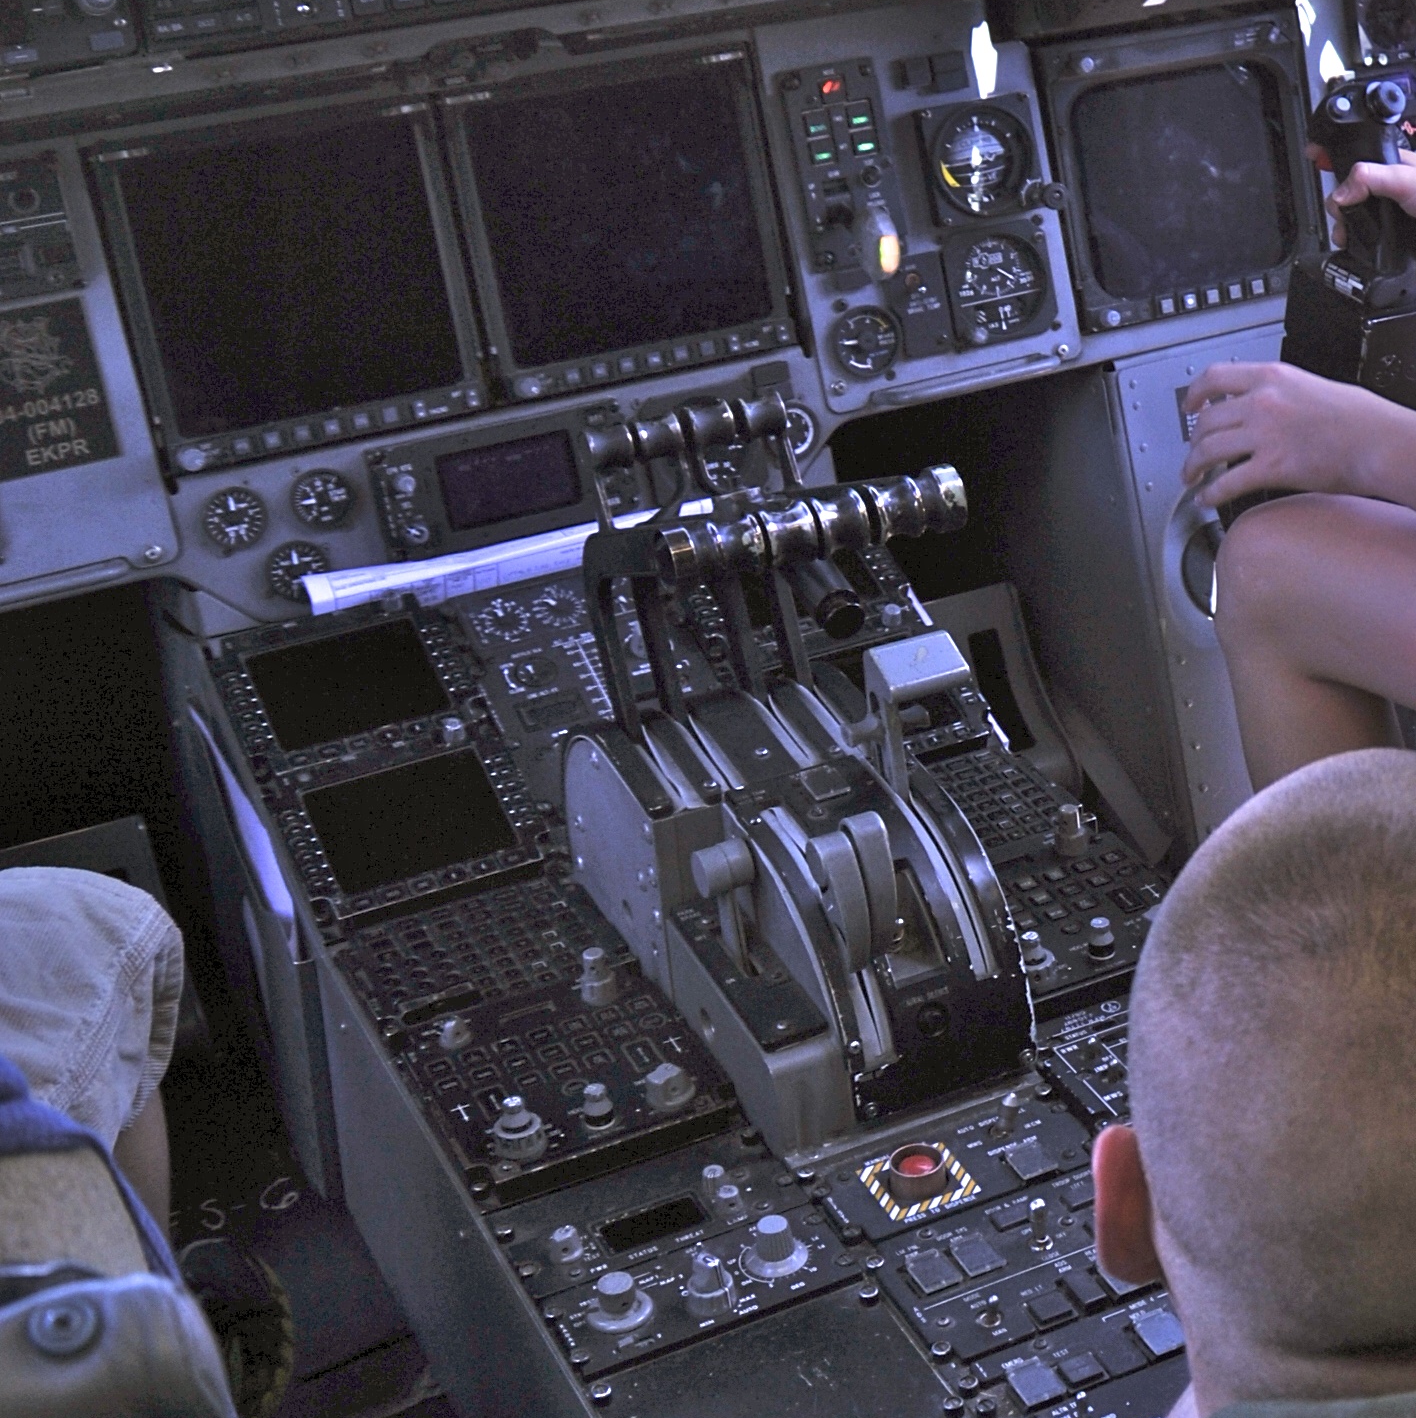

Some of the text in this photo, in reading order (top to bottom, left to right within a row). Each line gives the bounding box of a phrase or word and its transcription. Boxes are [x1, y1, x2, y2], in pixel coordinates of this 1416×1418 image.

[28, 417, 76, 445] (FM)
[25, 439, 91, 466] EKPR
[904, 1213, 927, 1225] PRESS
[944, 1194, 977, 1211] DISPENSE
[674, 1229, 704, 1244] THREAT
[628, 1245, 659, 1261] STATUS
